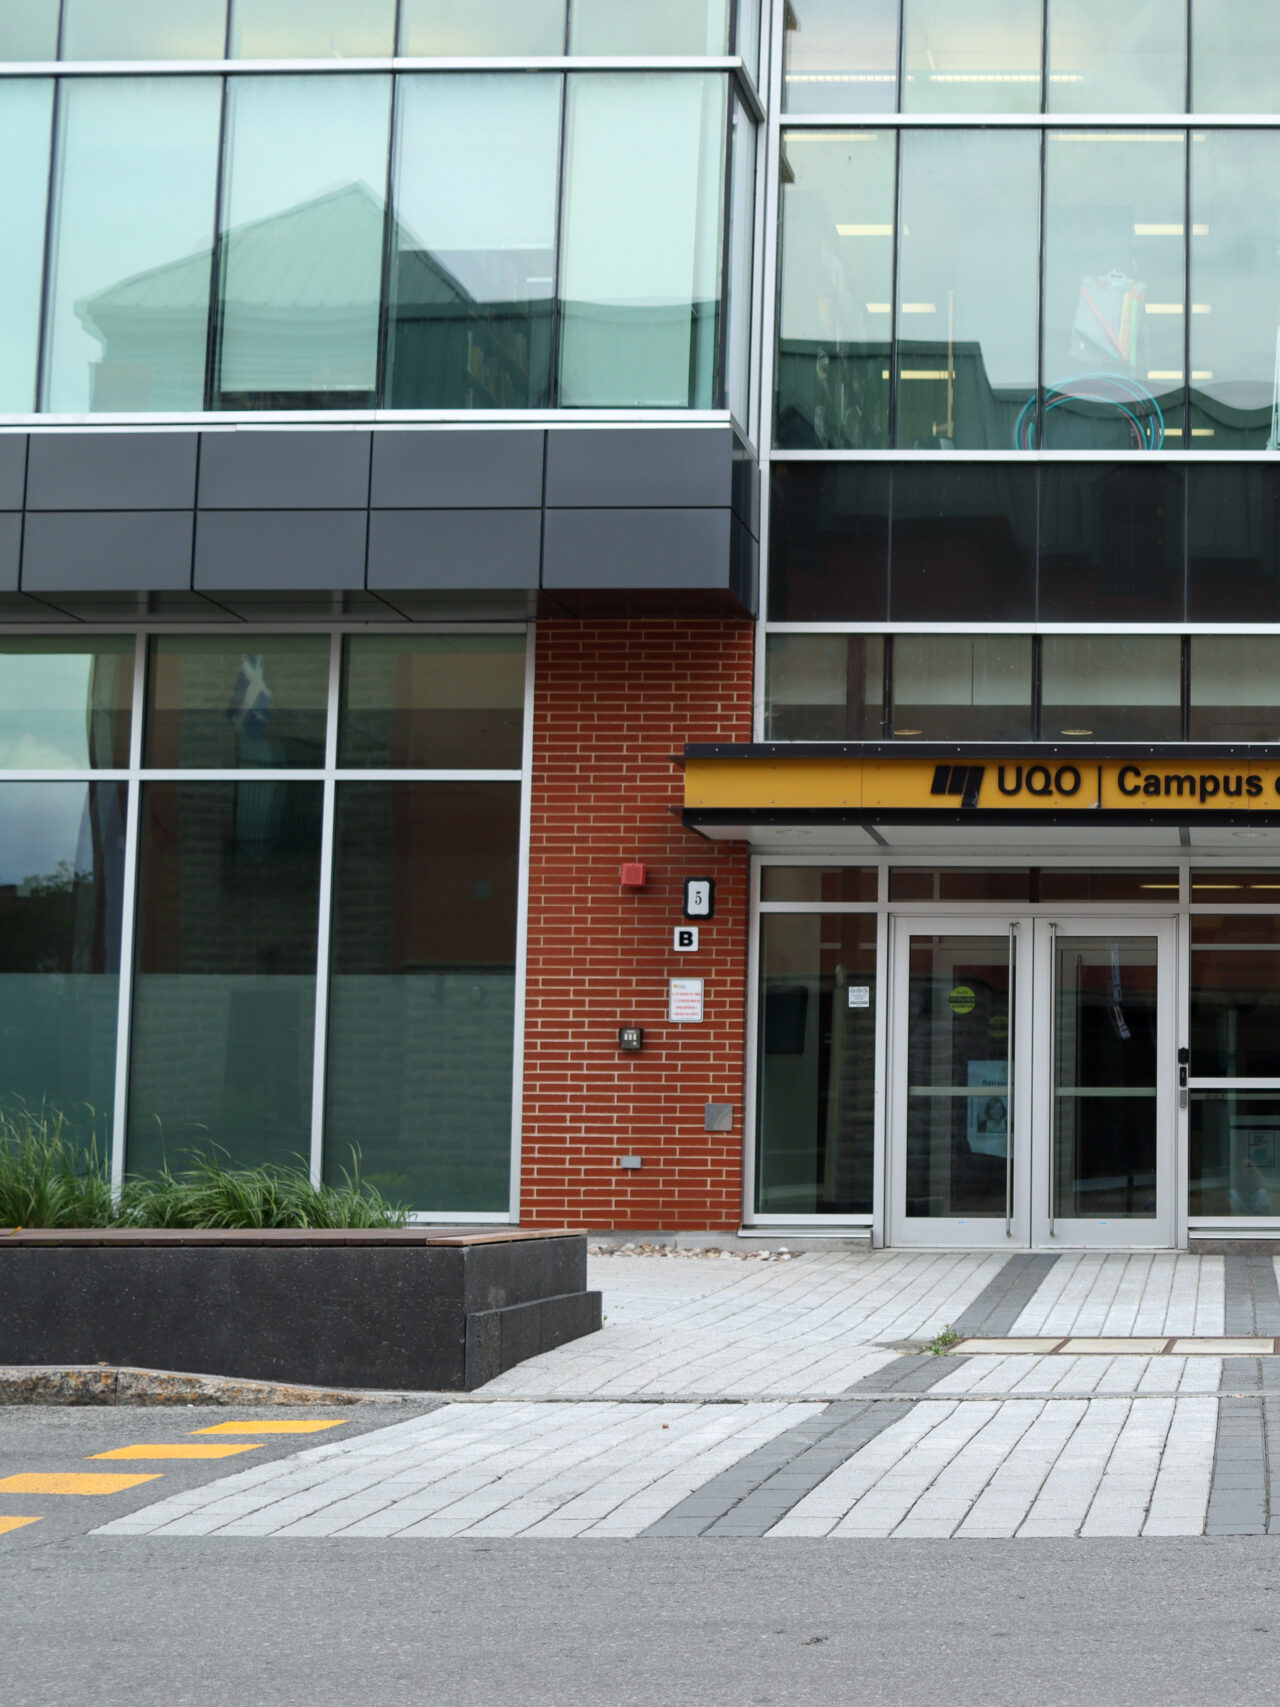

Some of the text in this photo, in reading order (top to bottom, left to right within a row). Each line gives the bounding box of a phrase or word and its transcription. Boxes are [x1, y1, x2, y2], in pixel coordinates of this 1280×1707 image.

[997, 765, 1081, 797] UQO
[1117, 765, 1263, 803] Campus
[694, 890, 702, 906] 5
[679, 931, 694, 947] B
